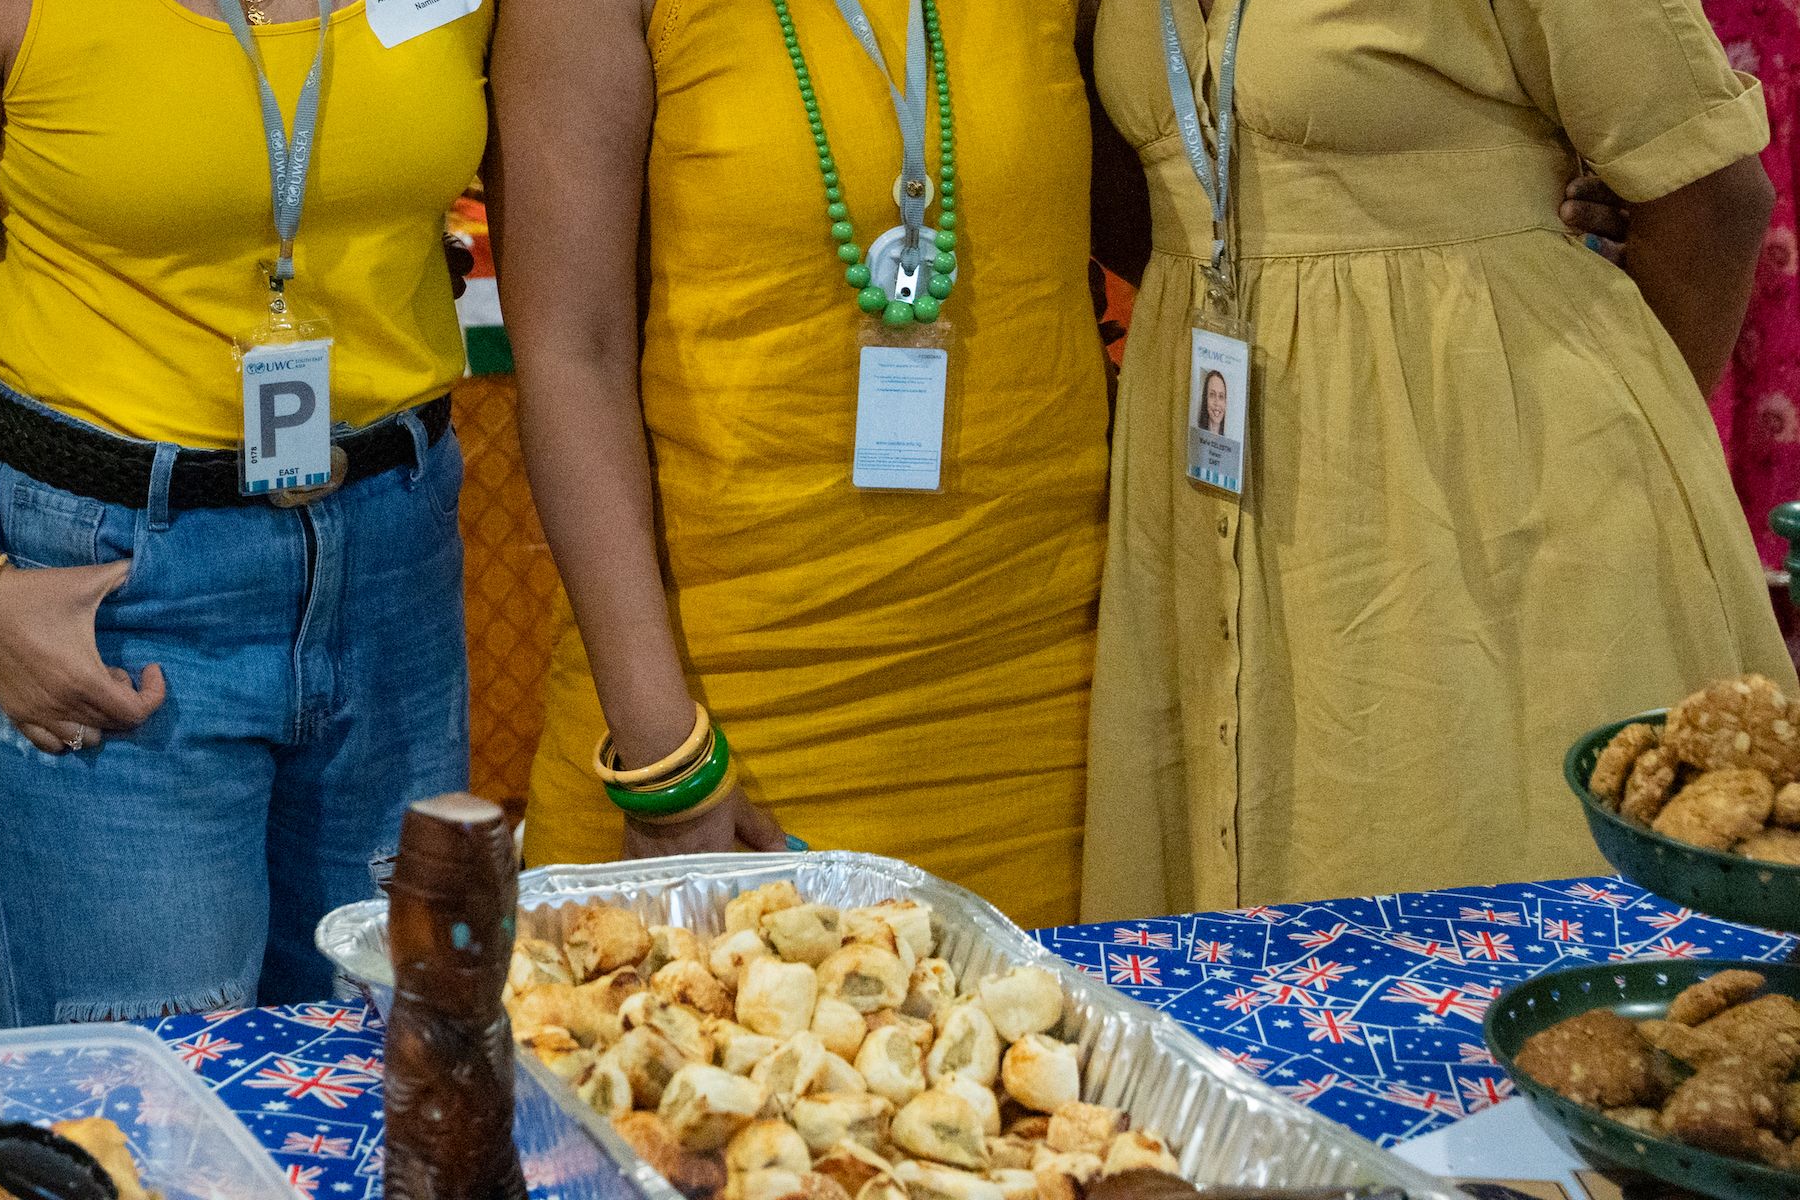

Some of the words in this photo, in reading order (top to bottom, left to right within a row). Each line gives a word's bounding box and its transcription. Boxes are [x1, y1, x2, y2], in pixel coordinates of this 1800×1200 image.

[290, 130, 310, 186] UWCSEA
[1183, 112, 1204, 170] UWCSEA
[266, 359, 295, 373] UWC
[259, 380, 316, 459] P
[279, 467, 300, 477] EAST
